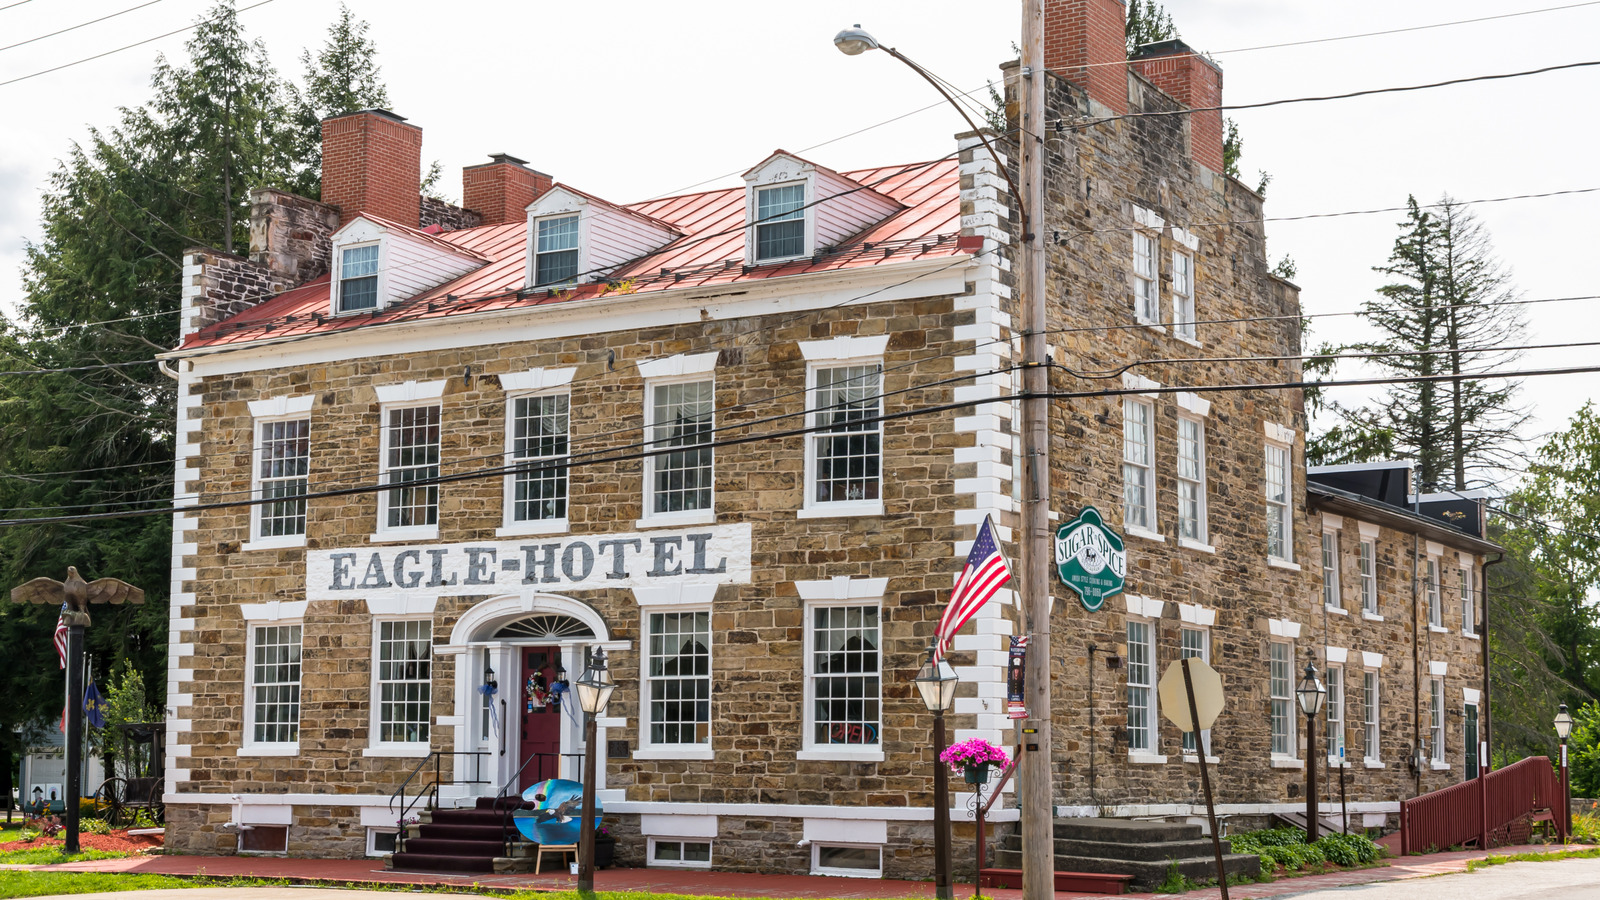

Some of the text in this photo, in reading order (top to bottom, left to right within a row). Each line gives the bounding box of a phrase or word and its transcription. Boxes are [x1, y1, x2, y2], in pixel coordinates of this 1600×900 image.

[328, 532, 727, 591] EAGLE-HOTEL
[1059, 526, 1094, 561] SUGAR
[1097, 533, 1123, 575] SPICE
[1081, 575, 1089, 583] STYLE
[830, 721, 872, 744] OPEN
